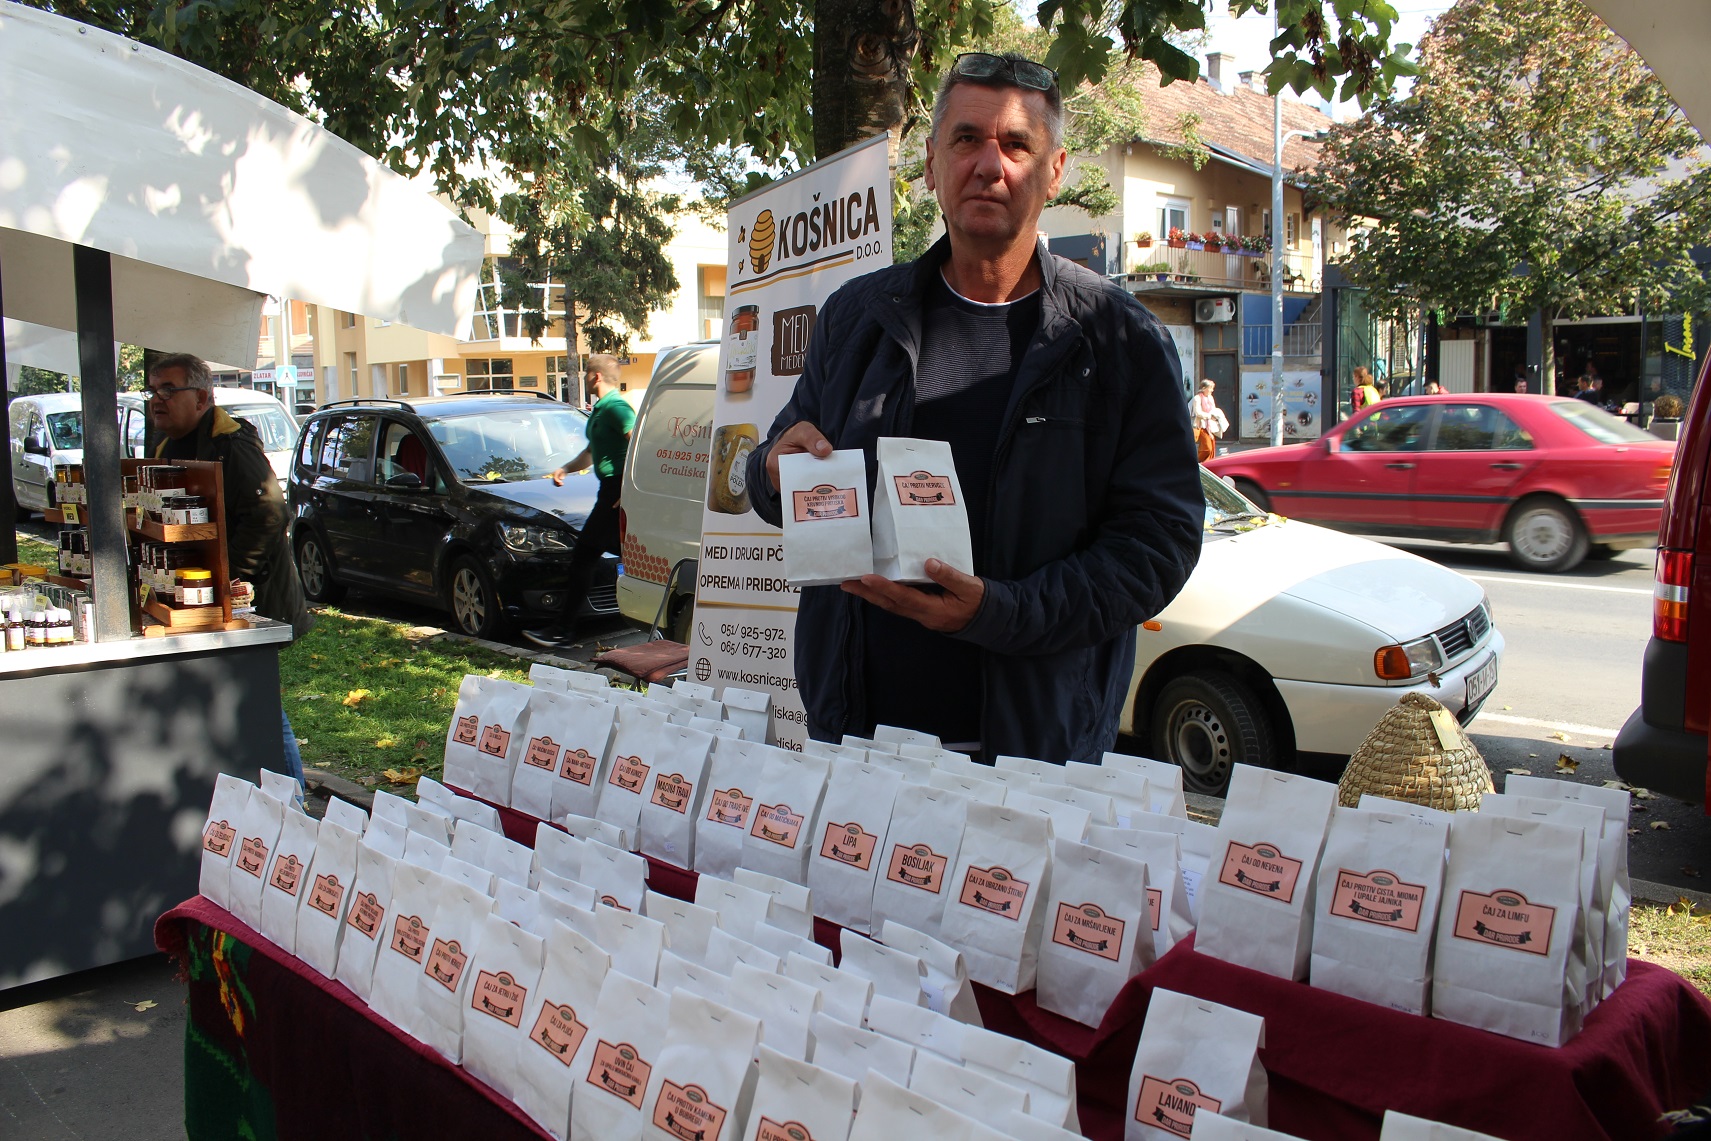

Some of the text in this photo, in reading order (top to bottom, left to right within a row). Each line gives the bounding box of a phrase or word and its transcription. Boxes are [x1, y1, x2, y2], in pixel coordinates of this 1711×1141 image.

[778, 186, 880, 262] KOŠNICA
[856, 240, 882, 260] D.O.O.
[781, 313, 808, 355] MED
[730, 477, 744, 488] POLEN
[705, 546, 728, 559] MED
[730, 546, 733, 560] I
[735, 546, 763, 560] DRUGI
[700, 574, 740, 589] OPREMA
[742, 577, 744, 590] I
[746, 578, 790, 593] PRIBOR
[720, 623, 786, 641] 051/ 925-972,
[720, 640, 786, 660] 065/ 677-320
[843, 834, 857, 849] LIPA
[902, 854, 936, 874] BOSILJAK
[1241, 854, 1284, 874] ČAJ OD NEVENA
[968, 874, 978, 884] ČAJ
[1341, 879, 1353, 890] ČAJ
[1353, 883, 1376, 894] PROTIV
[1397, 891, 1418, 902] MIOMA
[1357, 892, 1378, 902] UPALE
[1377, 896, 1402, 907] JAJNIKA
[1064, 912, 1074, 922] ČAJ
[1074, 916, 1081, 926] ZA
[1483, 904, 1530, 923] ČAJ ZA LIMFU
[625, 1060, 634, 1073] ČAJ
[667, 1090, 676, 1103] ČAJ
[676, 1095, 694, 1112] PROTIV
[693, 1103, 715, 1123] KAMENA
[1158, 1091, 1201, 1117] LAVAND
[679, 1108, 702, 1126] BUBREGU
